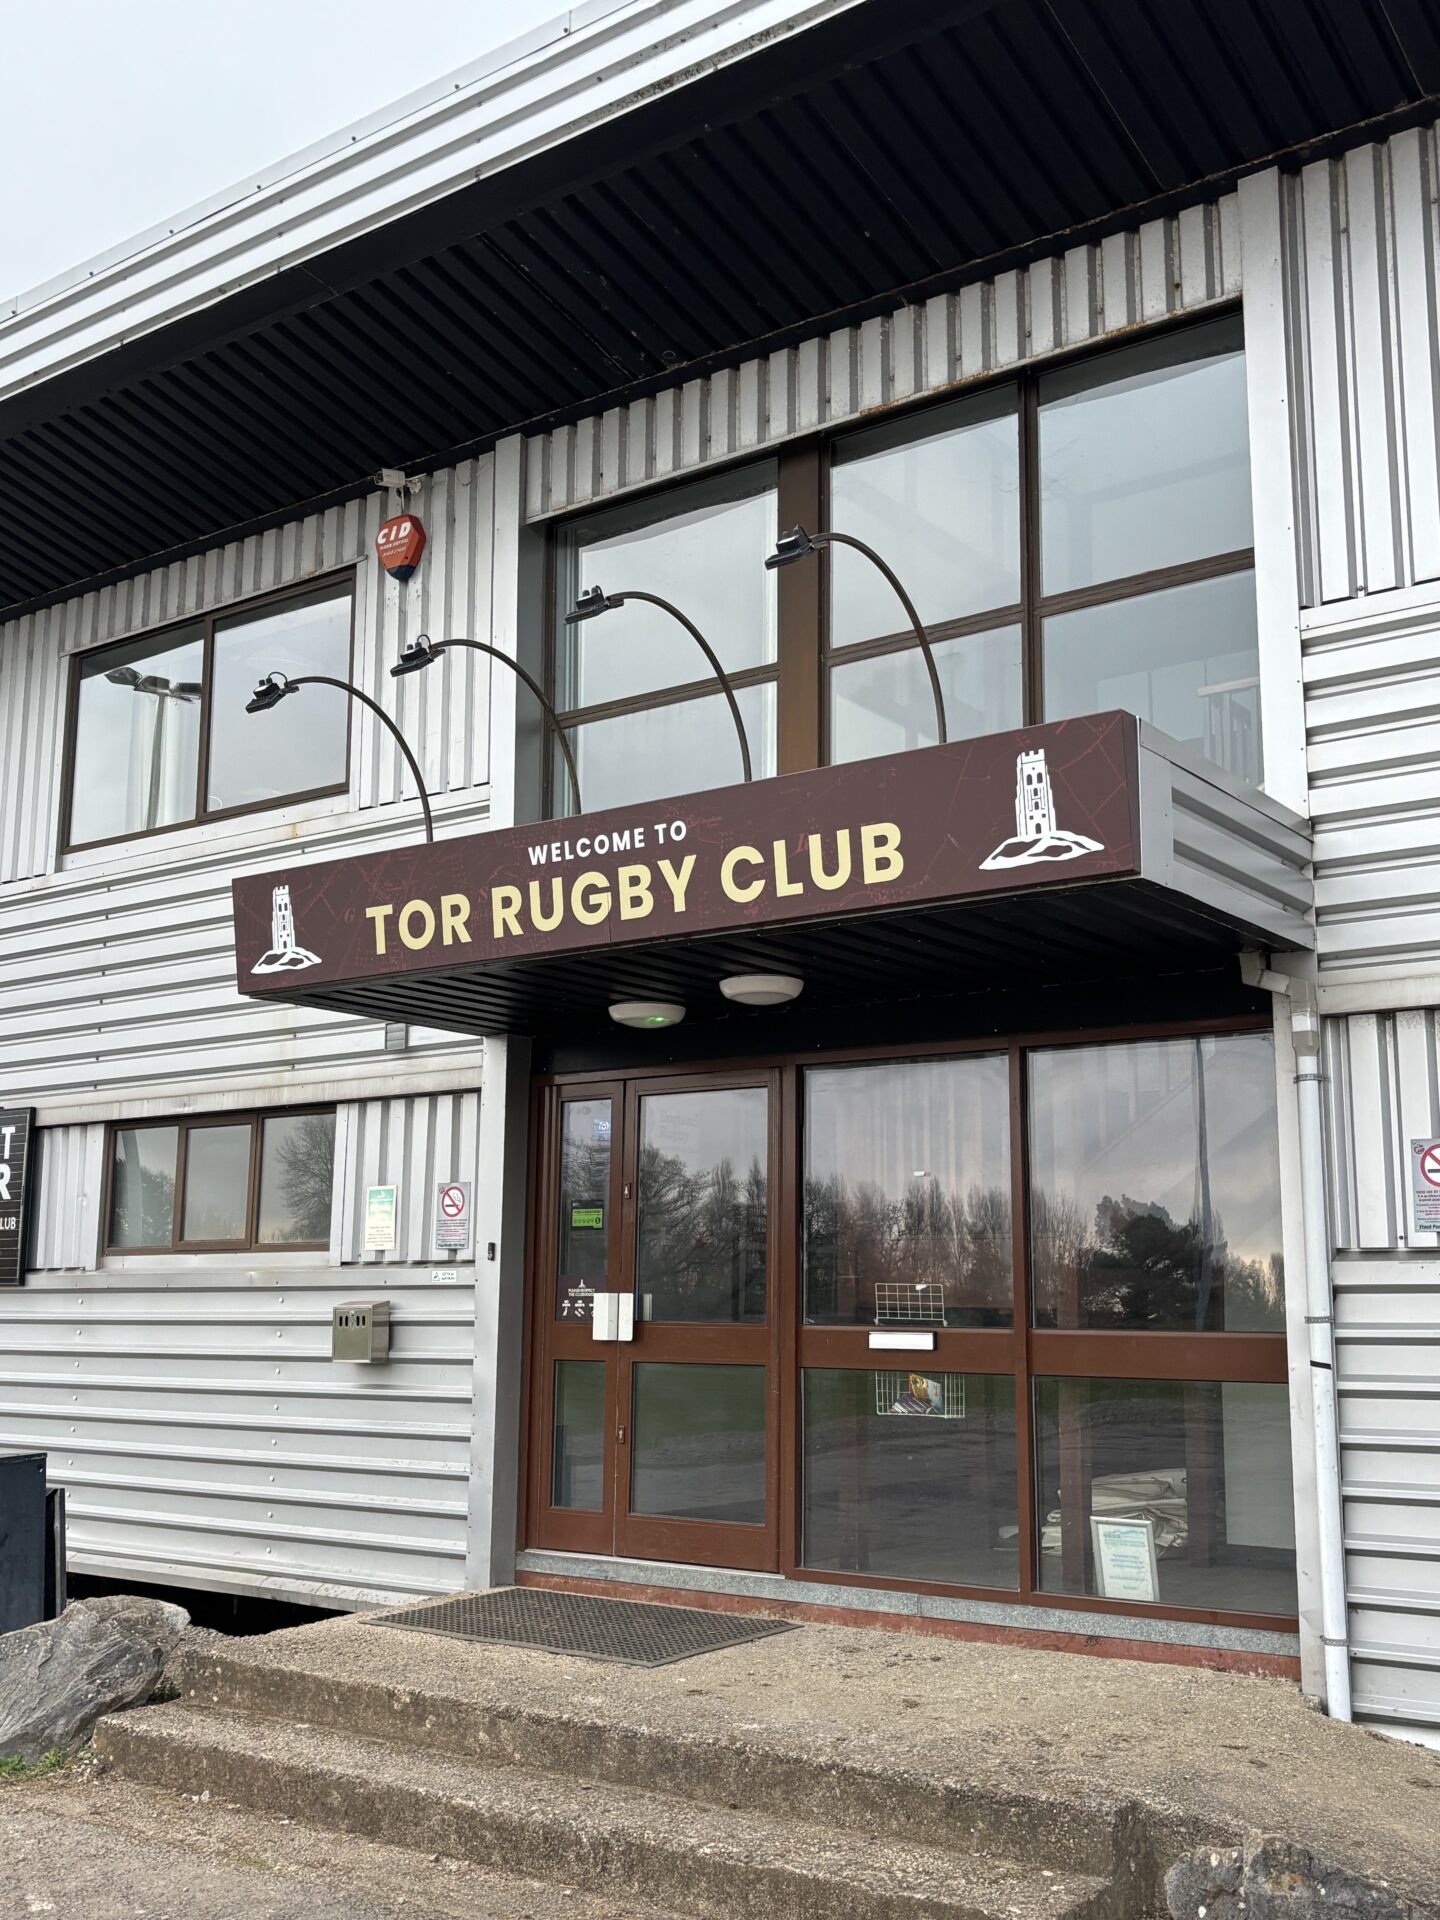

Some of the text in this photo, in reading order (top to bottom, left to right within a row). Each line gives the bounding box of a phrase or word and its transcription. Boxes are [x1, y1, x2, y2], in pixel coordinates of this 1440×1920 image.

[377, 521, 411, 544] CID
[528, 827, 646, 867] WELCOME
[653, 820, 688, 846] TO
[365, 822, 905, 955] TOR RUGBY CLUB
[0, 1216, 17, 1231] LUB
